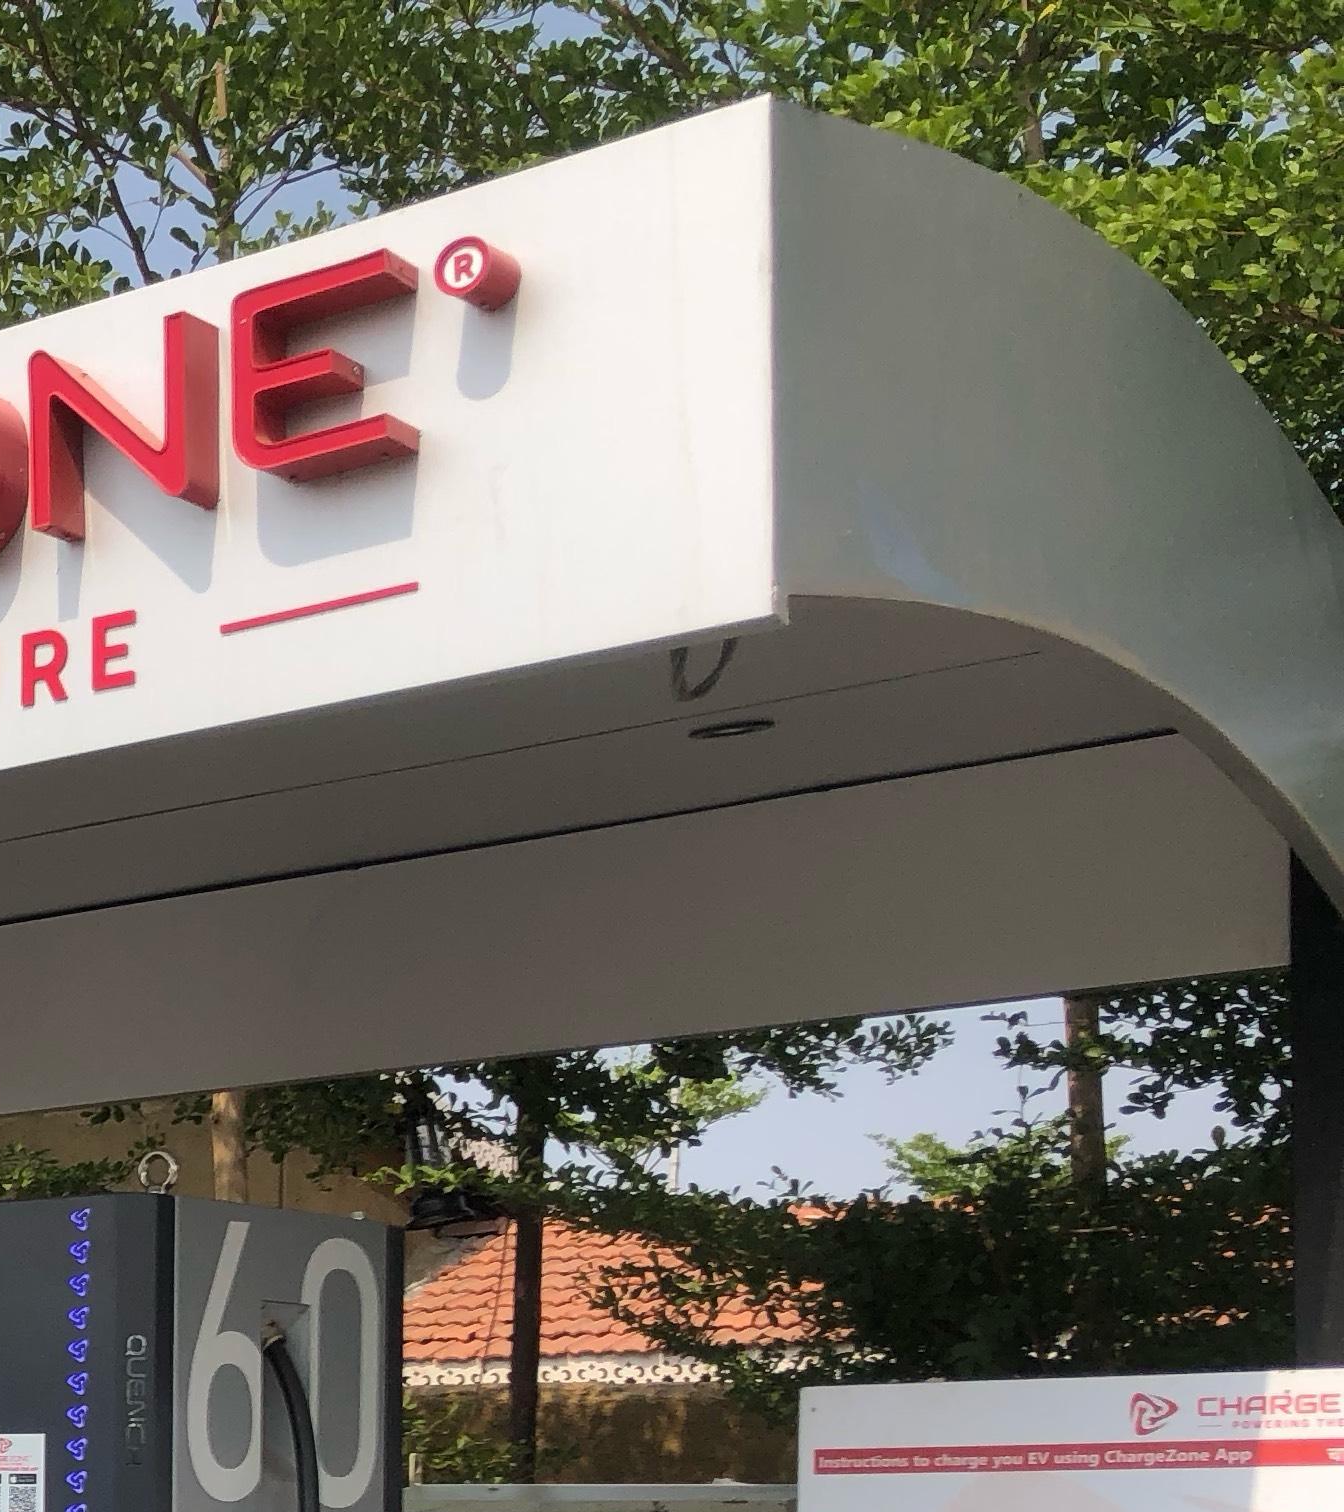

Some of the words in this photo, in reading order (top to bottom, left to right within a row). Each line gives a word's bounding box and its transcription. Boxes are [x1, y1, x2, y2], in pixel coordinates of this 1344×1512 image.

[187, 1221, 379, 1509] 60
[818, 1455, 909, 1469] Instructions
[913, 1456, 931, 1467] to
[934, 1454, 988, 1470] charge
[992, 1456, 1023, 1468] you
[1027, 1452, 1050, 1465] EV
[1054, 1452, 1100, 1467] using
[1104, 1449, 1211, 1467] ChargeZone
[1215, 1449, 1253, 1465] App
